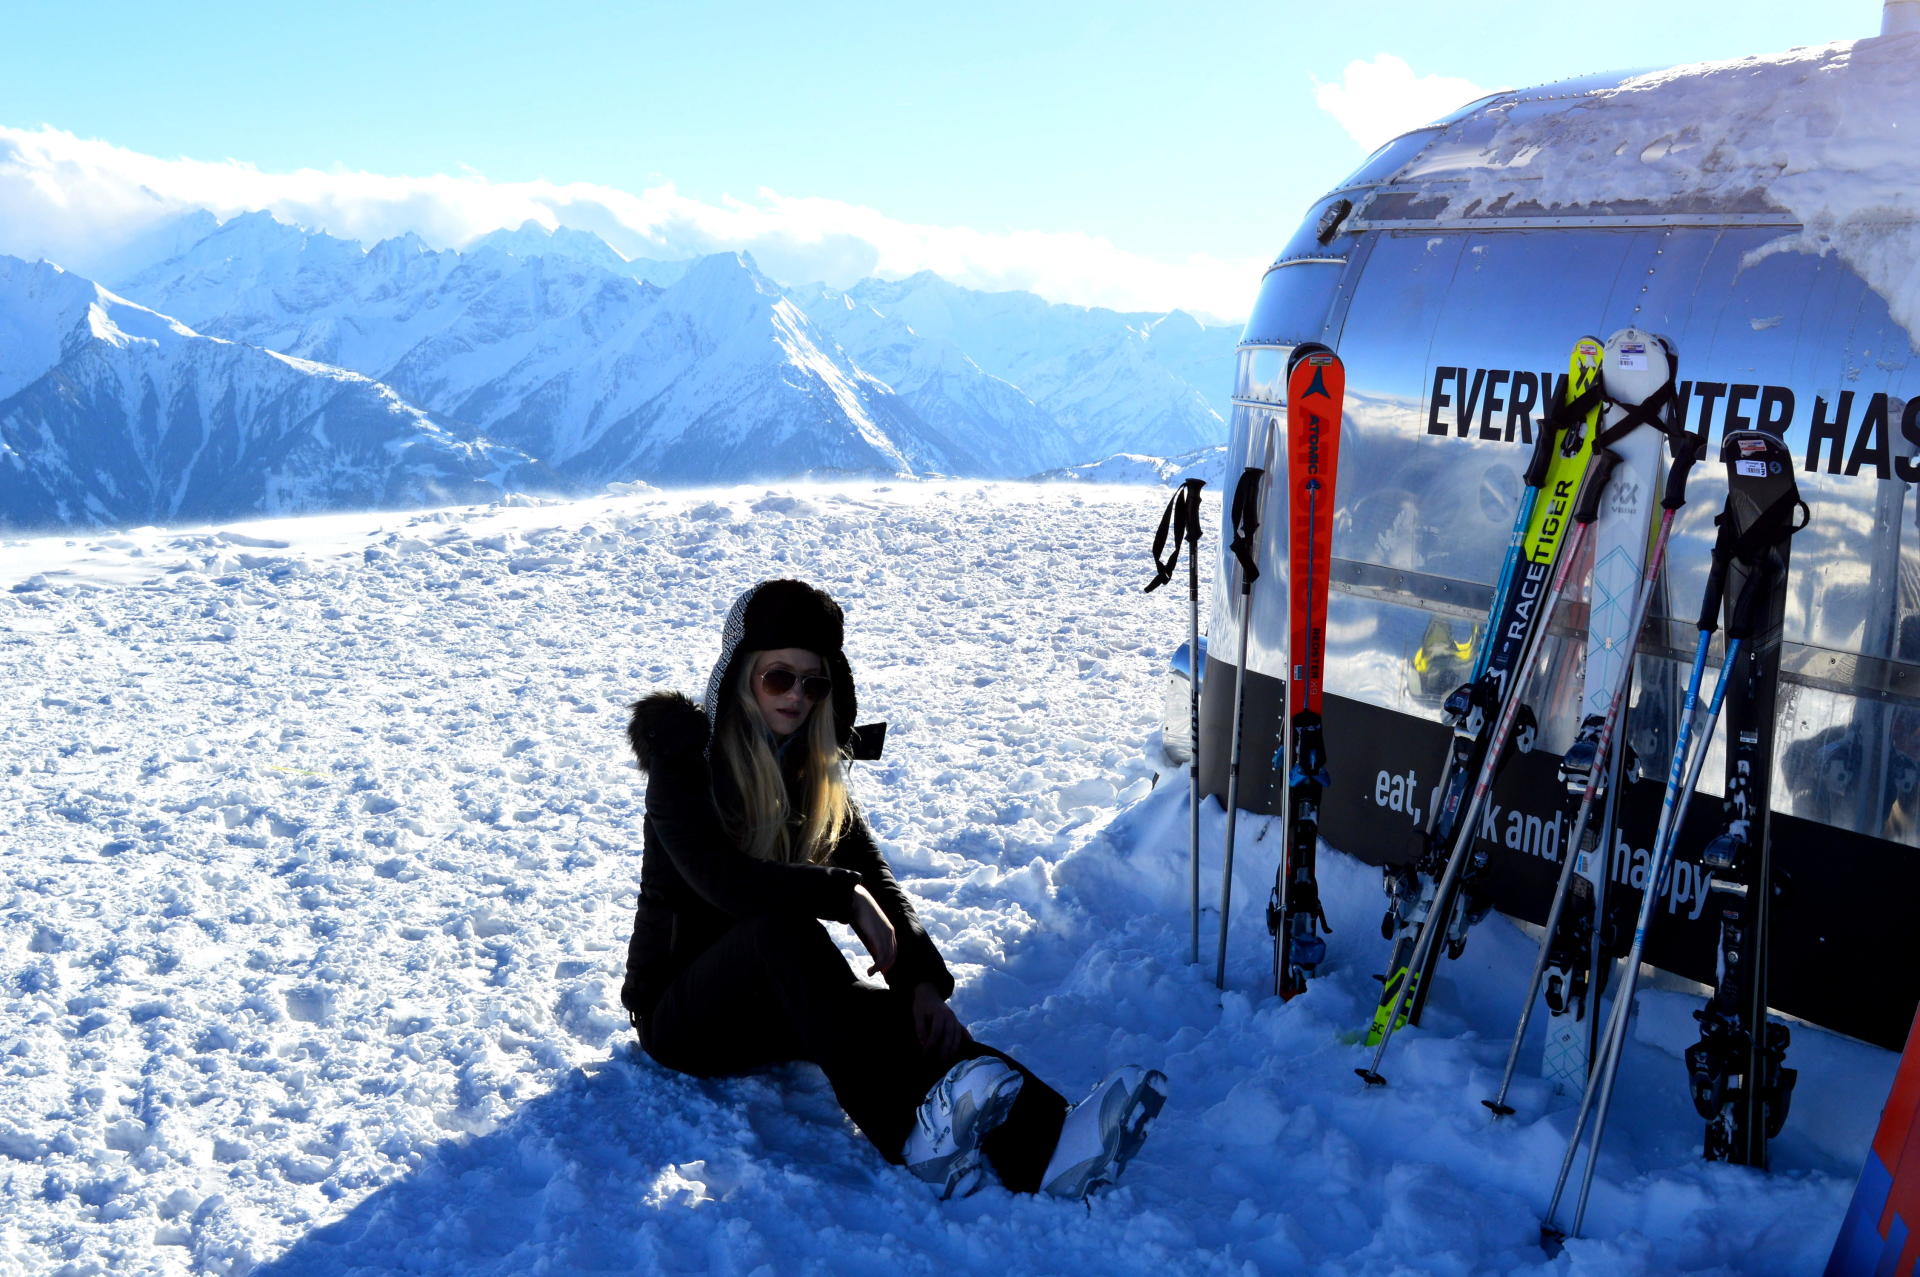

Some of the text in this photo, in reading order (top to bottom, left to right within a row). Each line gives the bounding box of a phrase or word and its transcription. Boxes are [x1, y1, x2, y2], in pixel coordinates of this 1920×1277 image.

[1307, 414, 1321, 475] ATOMIC
[1375, 769, 1421, 826] eat,
[1505, 809, 1562, 863] and
